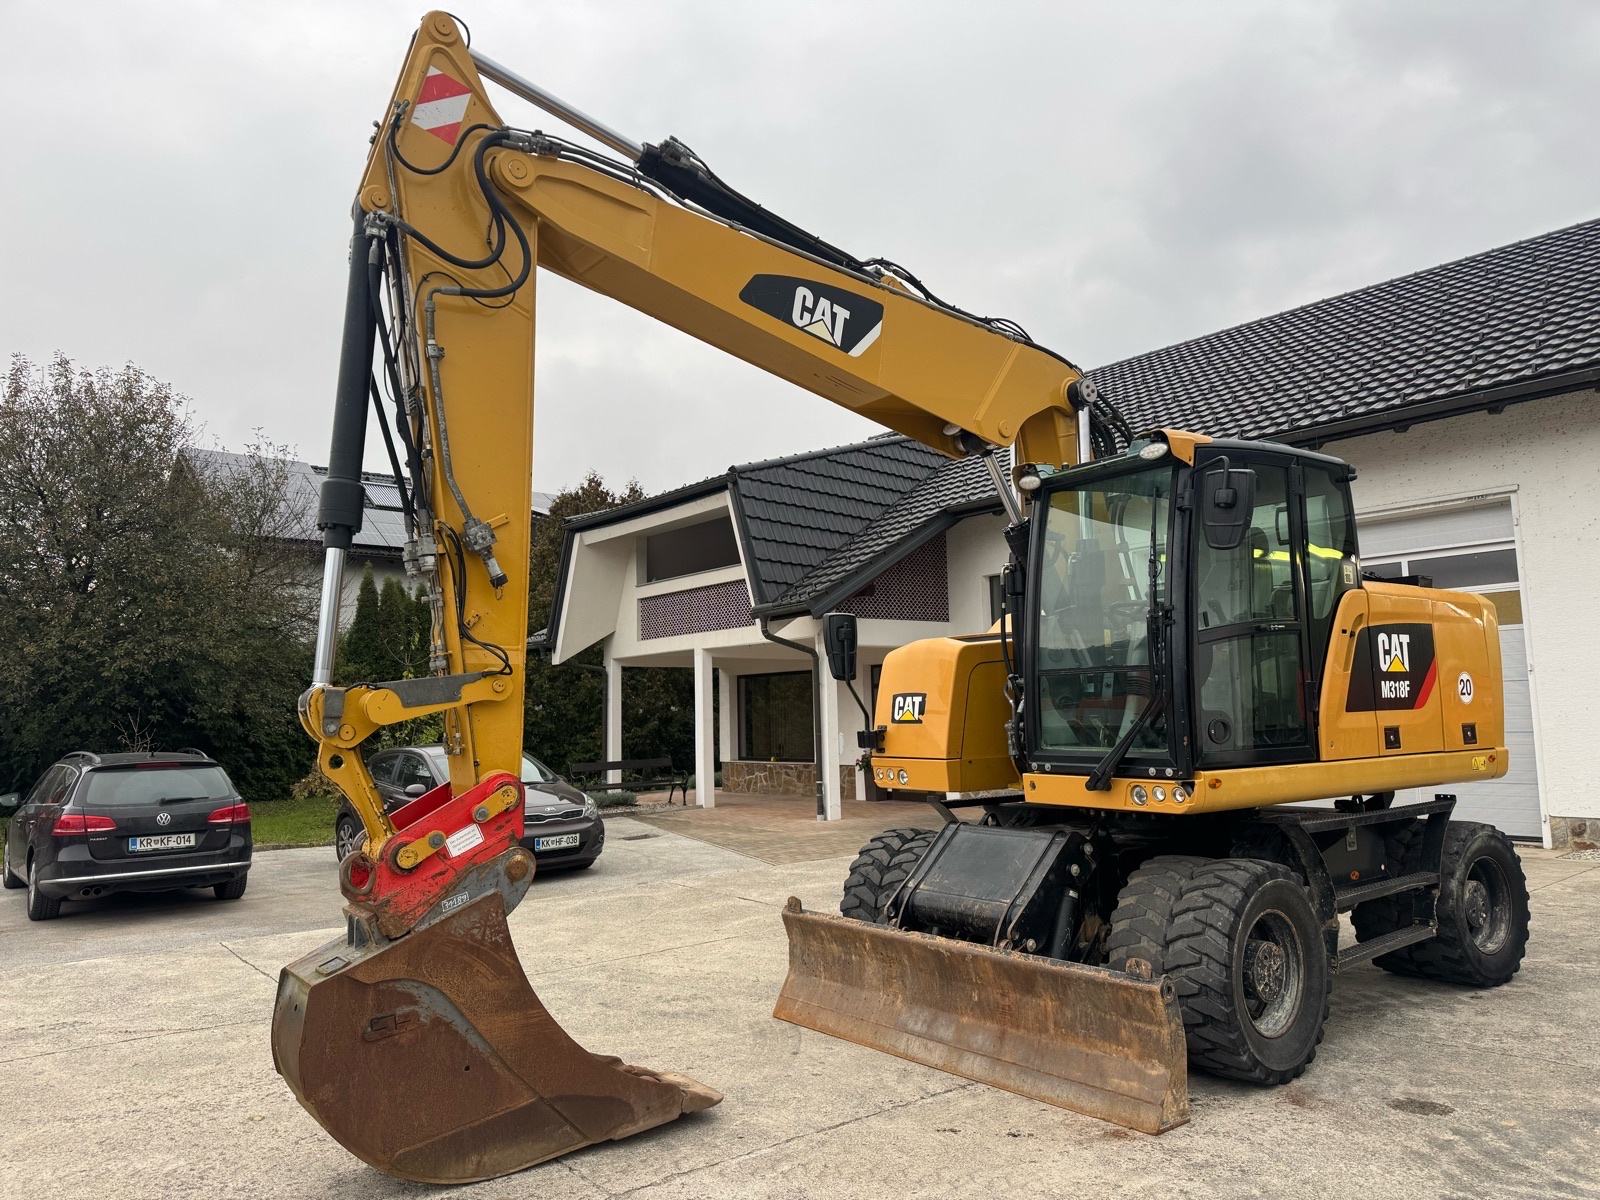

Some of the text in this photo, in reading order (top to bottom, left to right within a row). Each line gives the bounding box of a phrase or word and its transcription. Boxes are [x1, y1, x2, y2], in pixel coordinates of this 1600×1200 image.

[792, 286, 851, 347] CAT
[1377, 632, 1410, 673] CAT
[1381, 680, 1411, 699] M318F
[1459, 678, 1472, 696] 20
[894, 696, 923, 721] CAT
[139, 834, 192, 849] KR KF-014
[541, 835, 578, 849] KK HF-038
